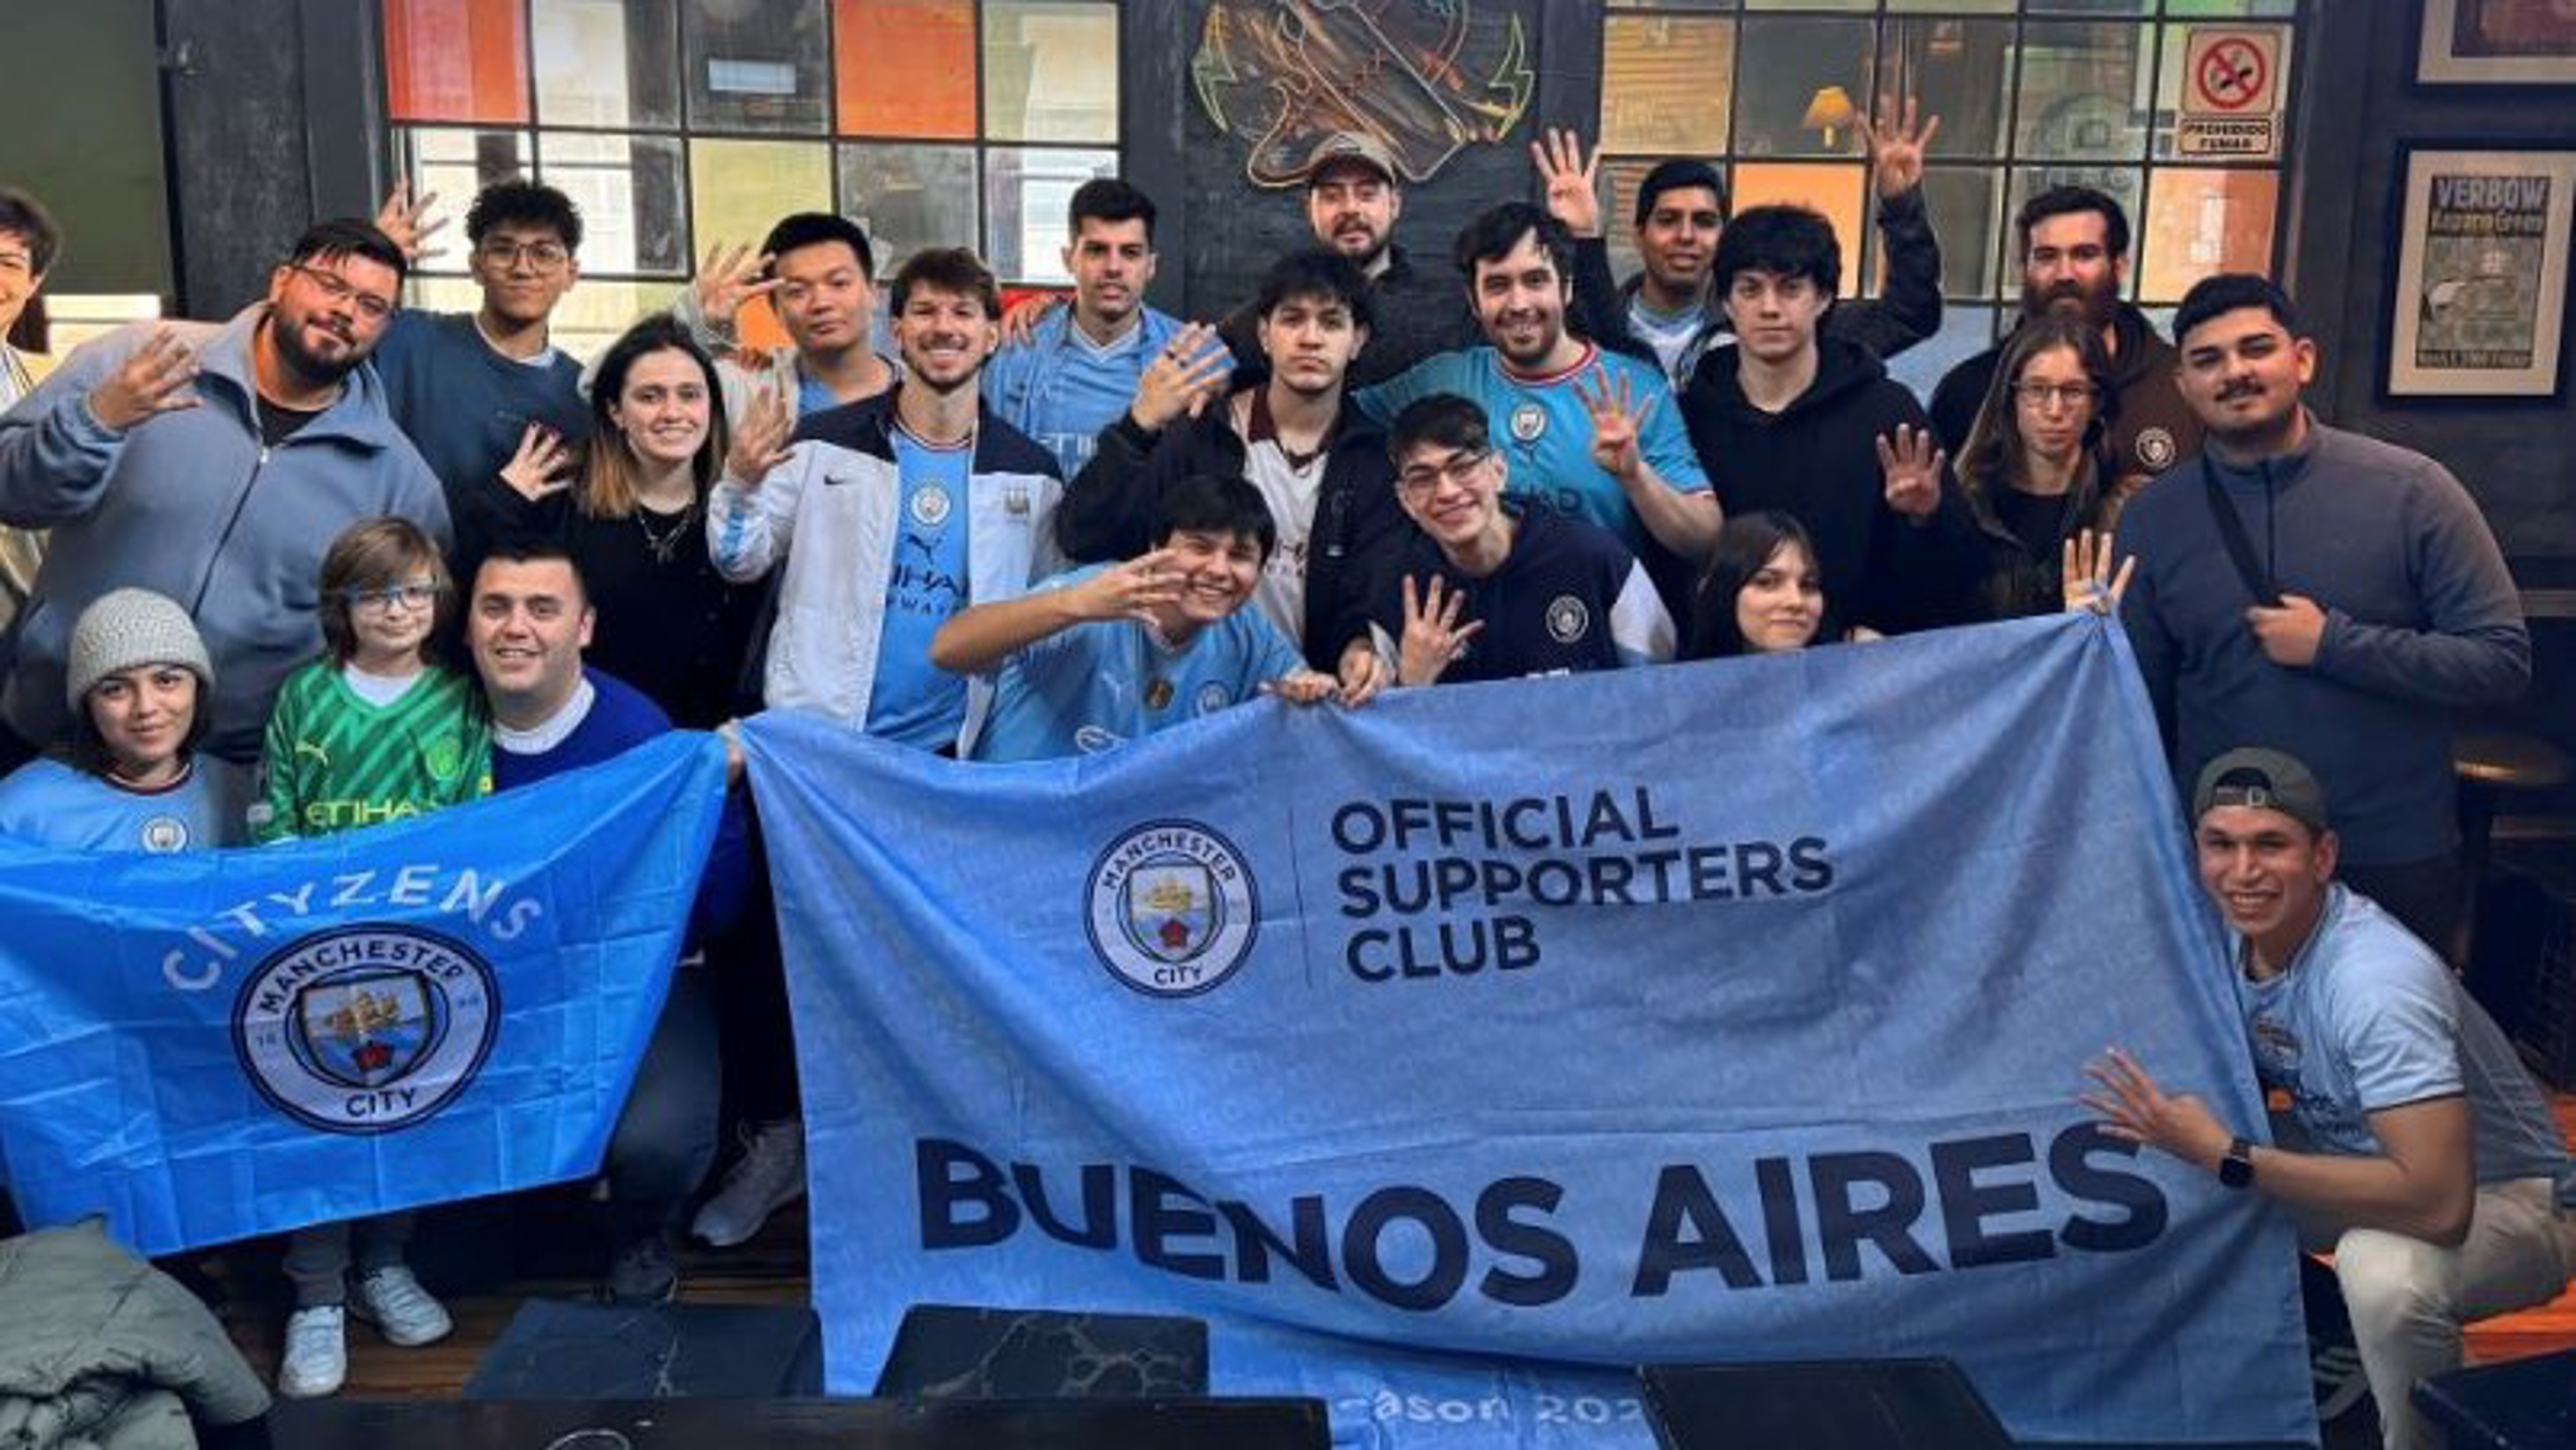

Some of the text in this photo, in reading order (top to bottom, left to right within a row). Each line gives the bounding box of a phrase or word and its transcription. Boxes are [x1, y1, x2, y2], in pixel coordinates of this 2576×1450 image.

[2435, 178, 2546, 209] VERBOW
[305, 798, 421, 825] ETIHA
[1331, 787, 1680, 854] OFFICIAL
[1102, 832, 1236, 890] MANCHESTER
[1338, 837, 1834, 918] SUPPORTERS
[162, 865, 541, 990] CITYZENS
[1346, 915, 1540, 982] CLUB
[260, 940, 463, 1014] MANCHESTER
[1153, 963, 1204, 985] CITY
[345, 1088, 417, 1117] CITY
[916, 1119, 2169, 1311] BUENOS AIRES
